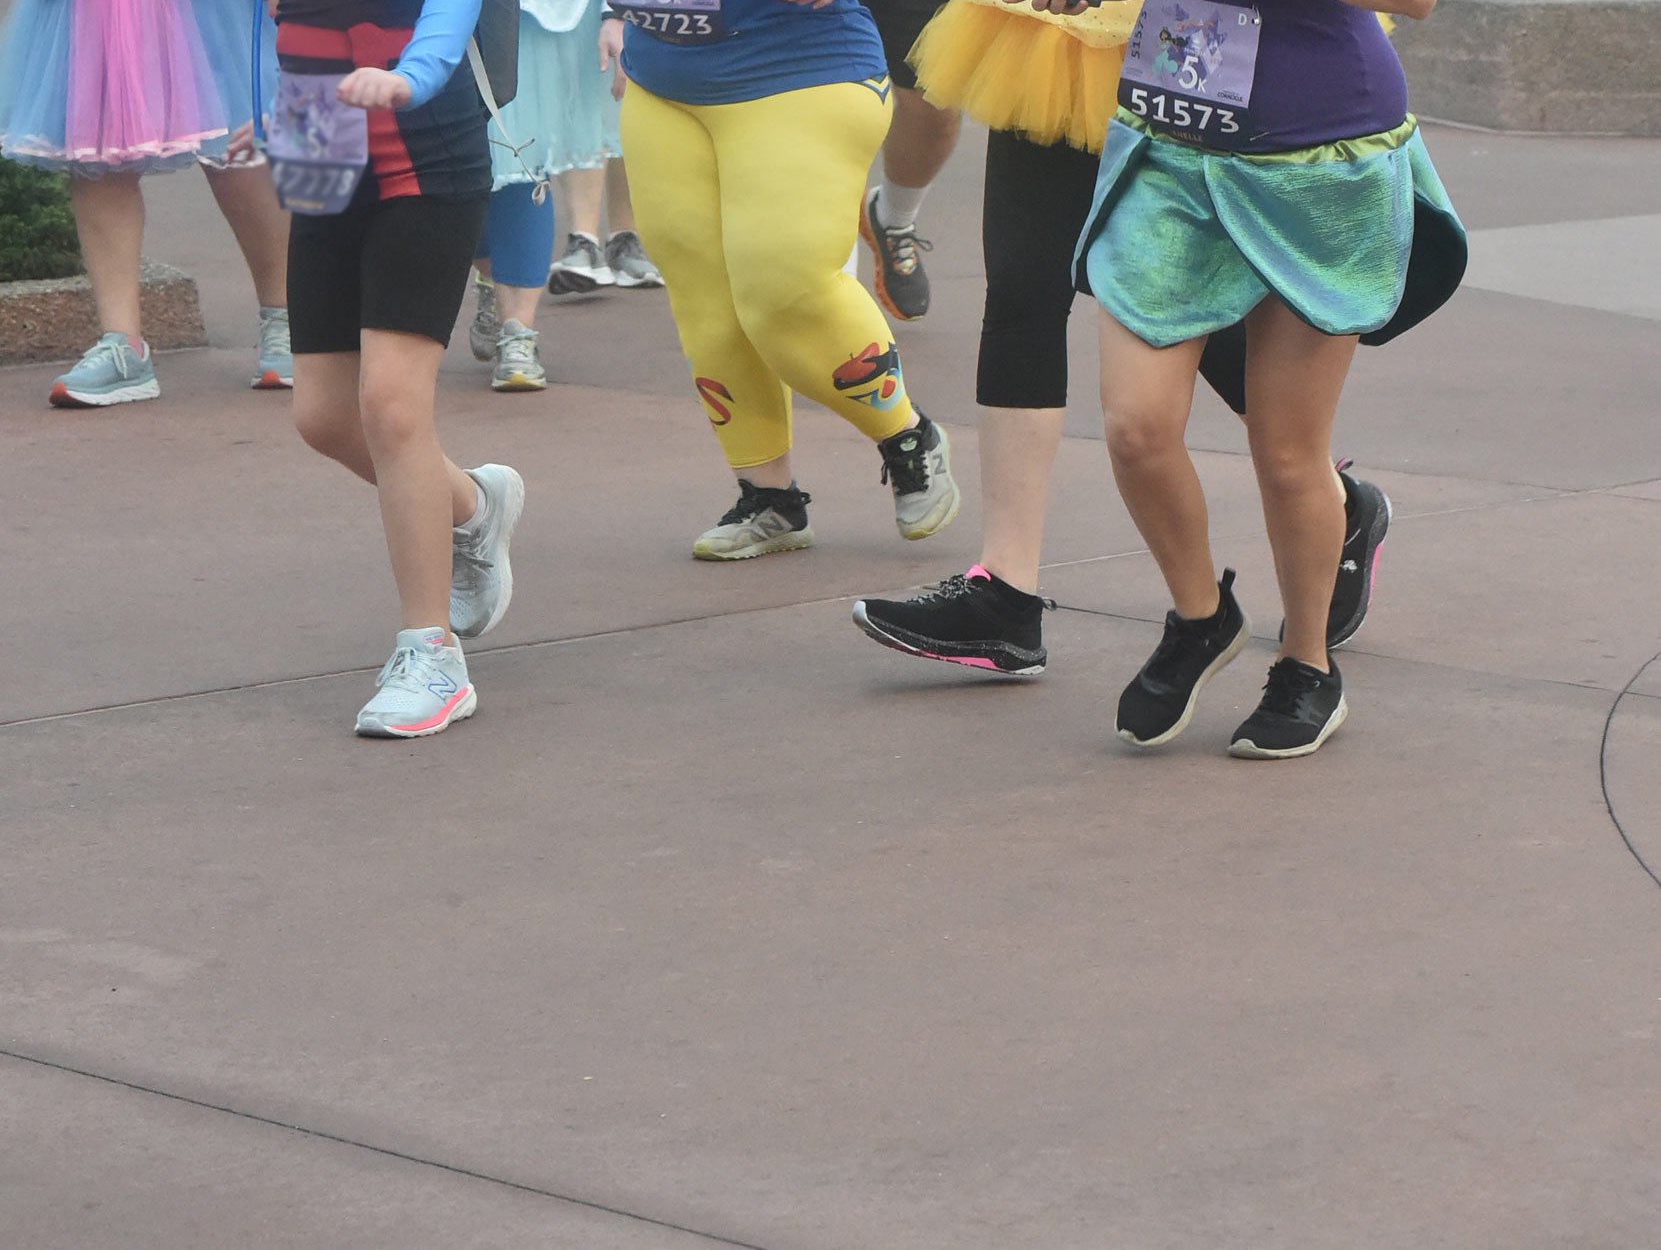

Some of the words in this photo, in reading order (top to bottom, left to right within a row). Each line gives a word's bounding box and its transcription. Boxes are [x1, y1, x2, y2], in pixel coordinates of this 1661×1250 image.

[622, 9, 713, 35] 42723
[1238, 13, 1247, 26] D
[1131, 88, 1240, 133] 51573
